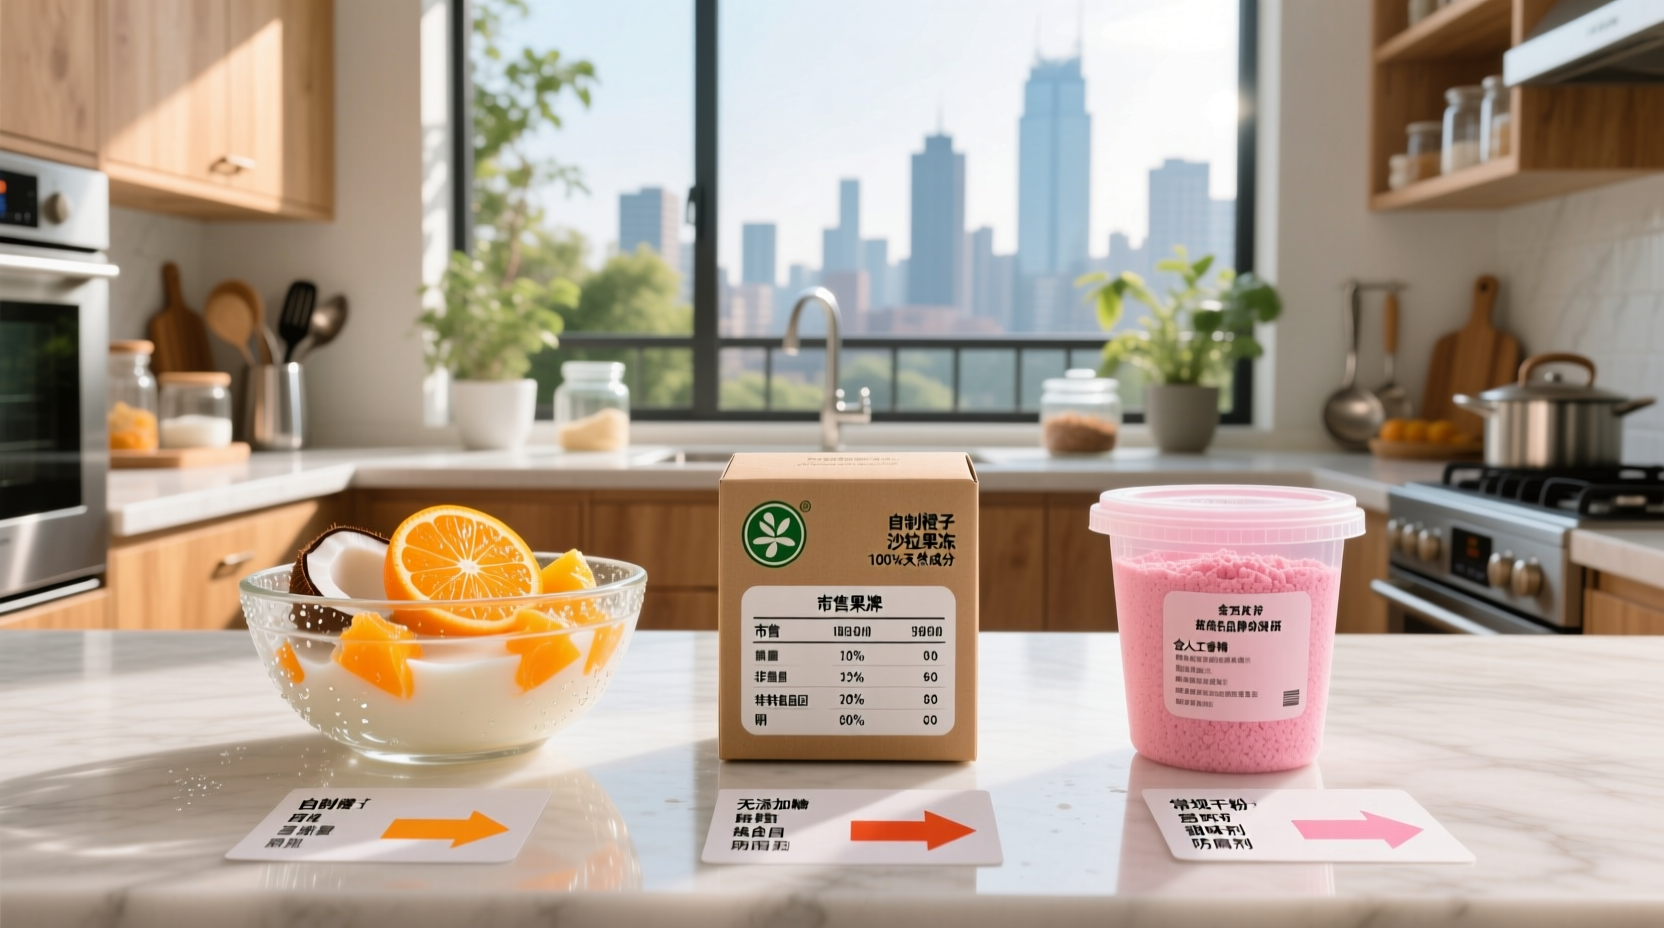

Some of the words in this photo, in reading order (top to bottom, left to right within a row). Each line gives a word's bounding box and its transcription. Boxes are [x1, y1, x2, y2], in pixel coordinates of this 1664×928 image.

[887, 532, 956, 550] 沙拉果冻
[840, 650, 865, 662] 10%
